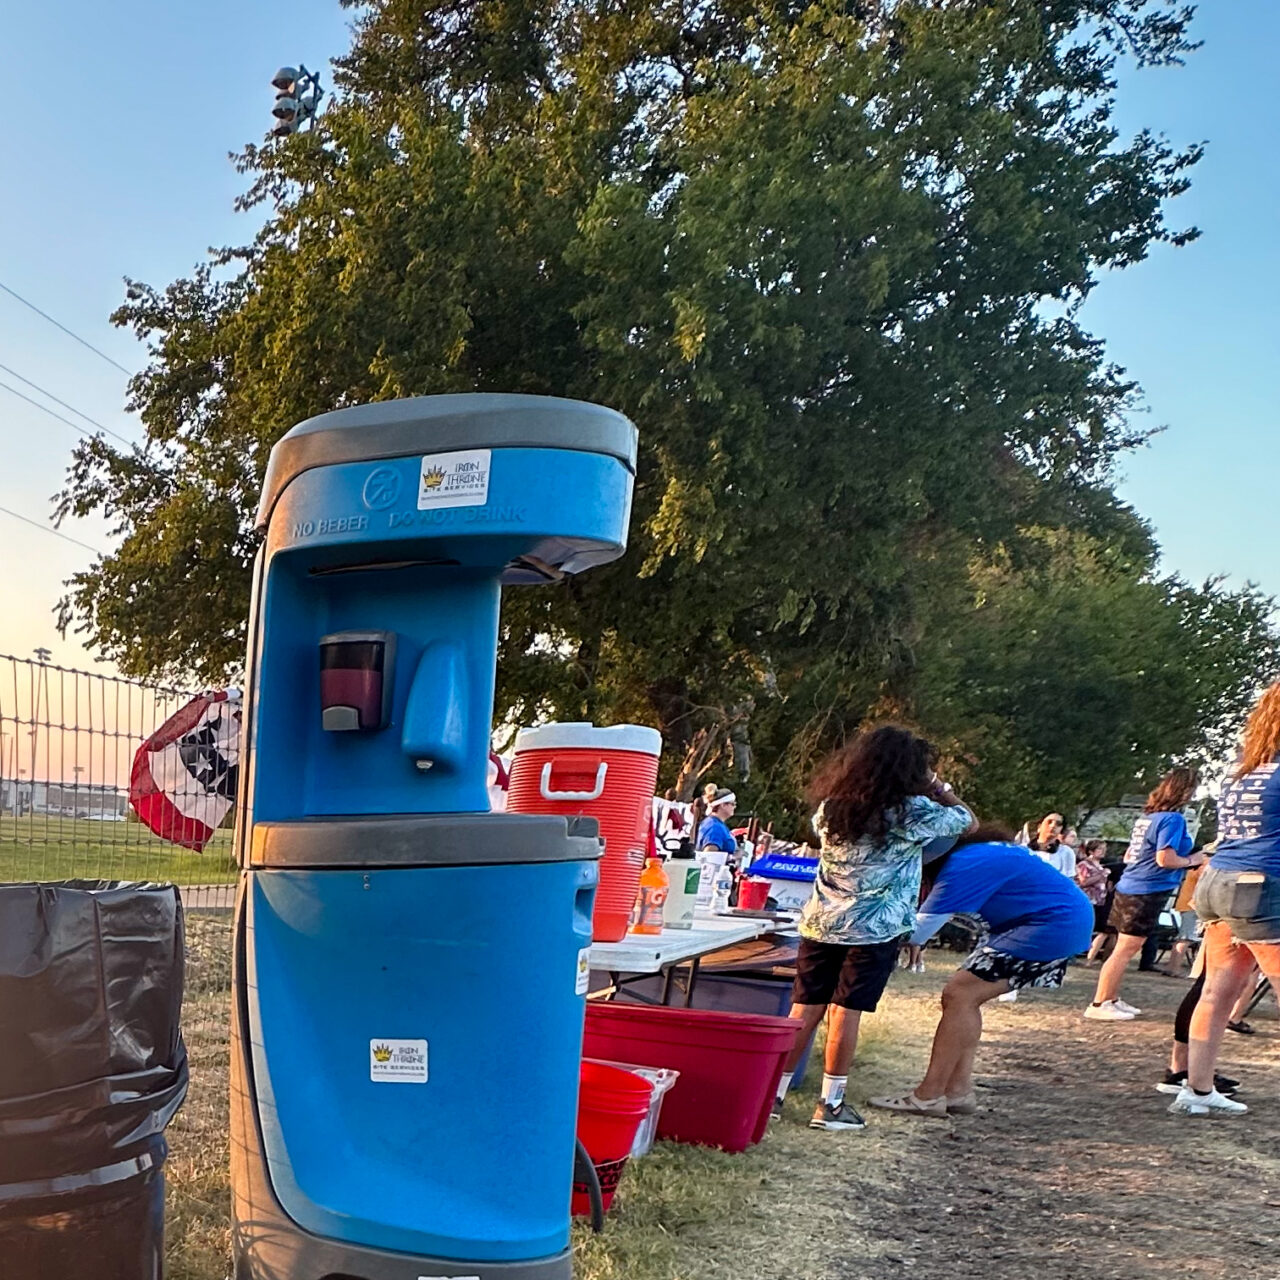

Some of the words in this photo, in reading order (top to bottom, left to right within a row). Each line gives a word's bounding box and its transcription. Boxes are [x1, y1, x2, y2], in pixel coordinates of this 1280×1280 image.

[292, 521, 315, 538] NO
[318, 515, 369, 535] BEBER
[388, 510, 416, 528] DO
